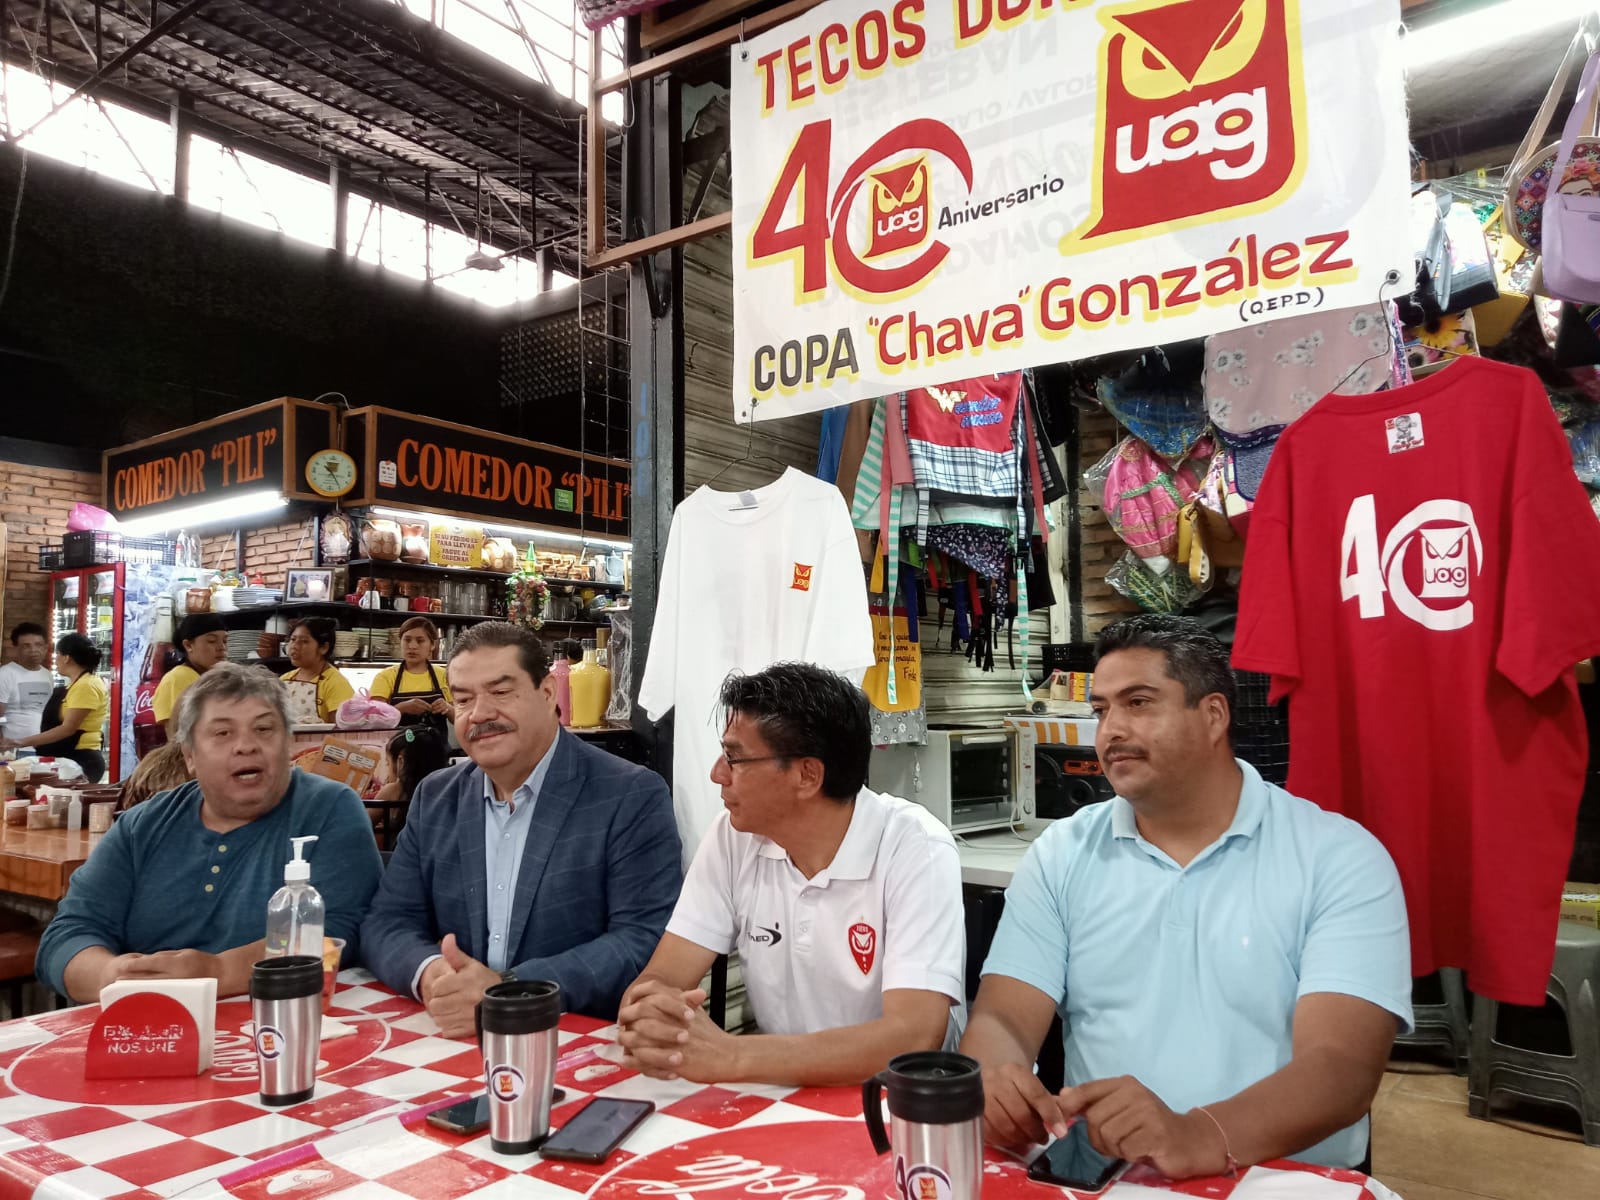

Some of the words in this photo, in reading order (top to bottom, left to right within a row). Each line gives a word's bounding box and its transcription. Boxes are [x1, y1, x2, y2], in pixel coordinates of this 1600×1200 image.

[757, 0, 926, 110] TECOS
[938, 174, 1065, 230] Aniversario
[754, 327, 859, 392] COPA
[1040, 229, 1353, 331] González
[1239, 286, 1324, 321] (QEPD)
[114, 448, 206, 512] COMEDOR
[397, 438, 553, 510] COMEDOR
[107, 1041, 141, 1054] NOS
[144, 1040, 177, 1053] UNE
